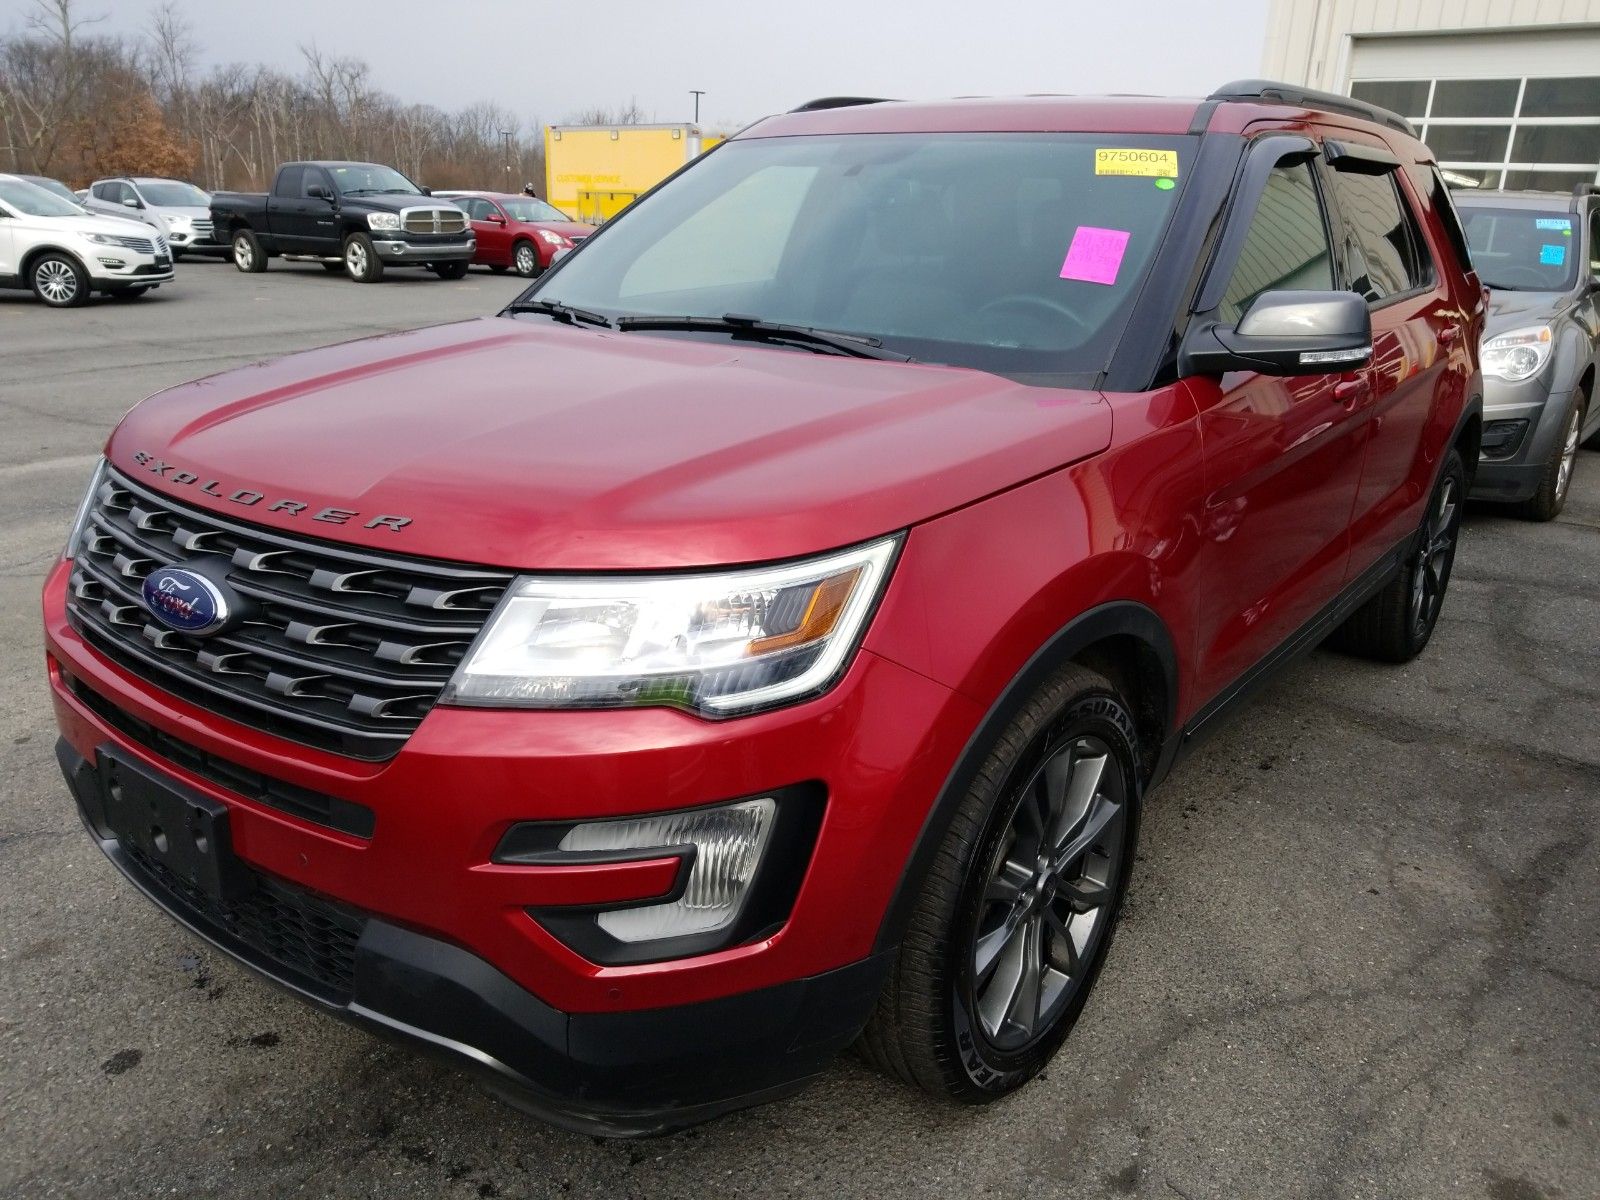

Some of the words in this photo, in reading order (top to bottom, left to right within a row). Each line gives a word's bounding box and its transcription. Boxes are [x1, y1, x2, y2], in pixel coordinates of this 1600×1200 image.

[1098, 151, 1168, 163] 9750604
[132, 450, 414, 532] EXPLORER
[151, 576, 206, 621] Ford
